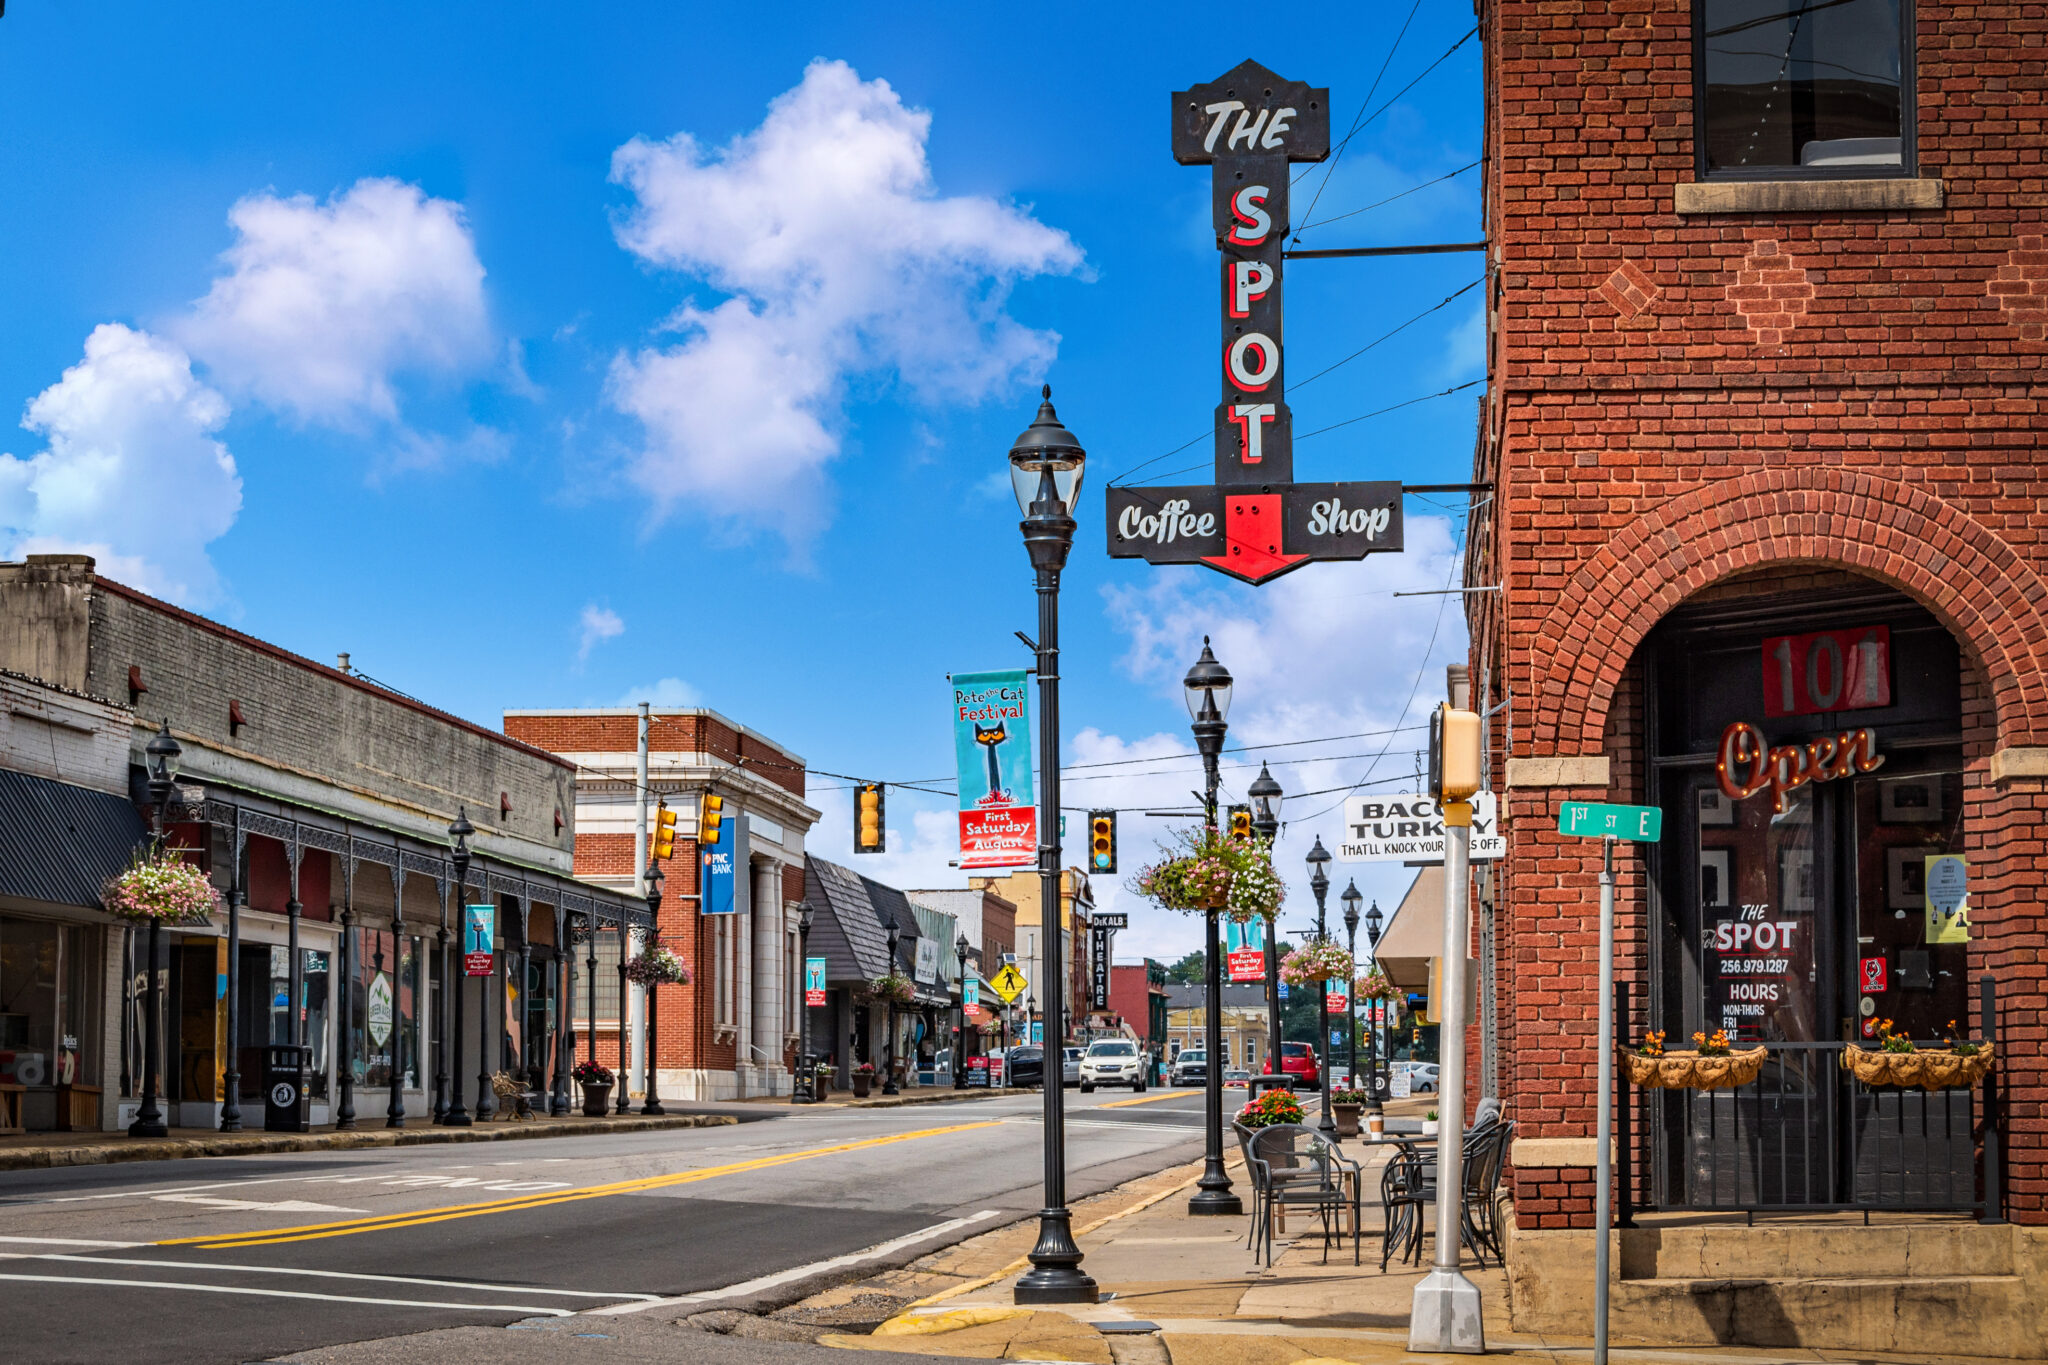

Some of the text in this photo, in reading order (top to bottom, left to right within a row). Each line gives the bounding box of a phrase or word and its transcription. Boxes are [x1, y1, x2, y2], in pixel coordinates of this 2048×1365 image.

[1203, 100, 1297, 153] THE
[1226, 185, 1279, 464] SPOT
[1118, 498, 1390, 544] Coffee Shop
[1773, 630, 1878, 712] 101
[955, 688, 1025, 704] Pete the Cat
[959, 701, 1023, 721] Festival
[1716, 722, 1886, 814] Open
[985, 811, 1011, 822] First
[1605, 814, 1617, 828] ST
[1639, 811, 1650, 836] E
[966, 820, 1031, 837] Saturday
[1350, 818, 1493, 839] TURKY
[974, 838, 1023, 852] August
[1341, 842, 1381, 857] THAT'LL
[1384, 842, 1417, 855] KNOCK
[1419, 840, 1445, 853] YOUR
[712, 852, 728, 864] PNC
[712, 864, 732, 875] BANK
[1740, 903, 1769, 921] THE
[1716, 921, 1798, 952] SPOT
[1095, 930, 1105, 1006] THEATRE
[1721, 959, 1789, 974] 256.979.1287
[1730, 983, 1779, 1001] HOURS
[1722, 1004, 1765, 1016] MON-THURS
[1723, 1017, 1737, 1028] FRI
[1724, 1029, 1738, 1041] SAT
[303, 1175, 573, 1191] ONLY
